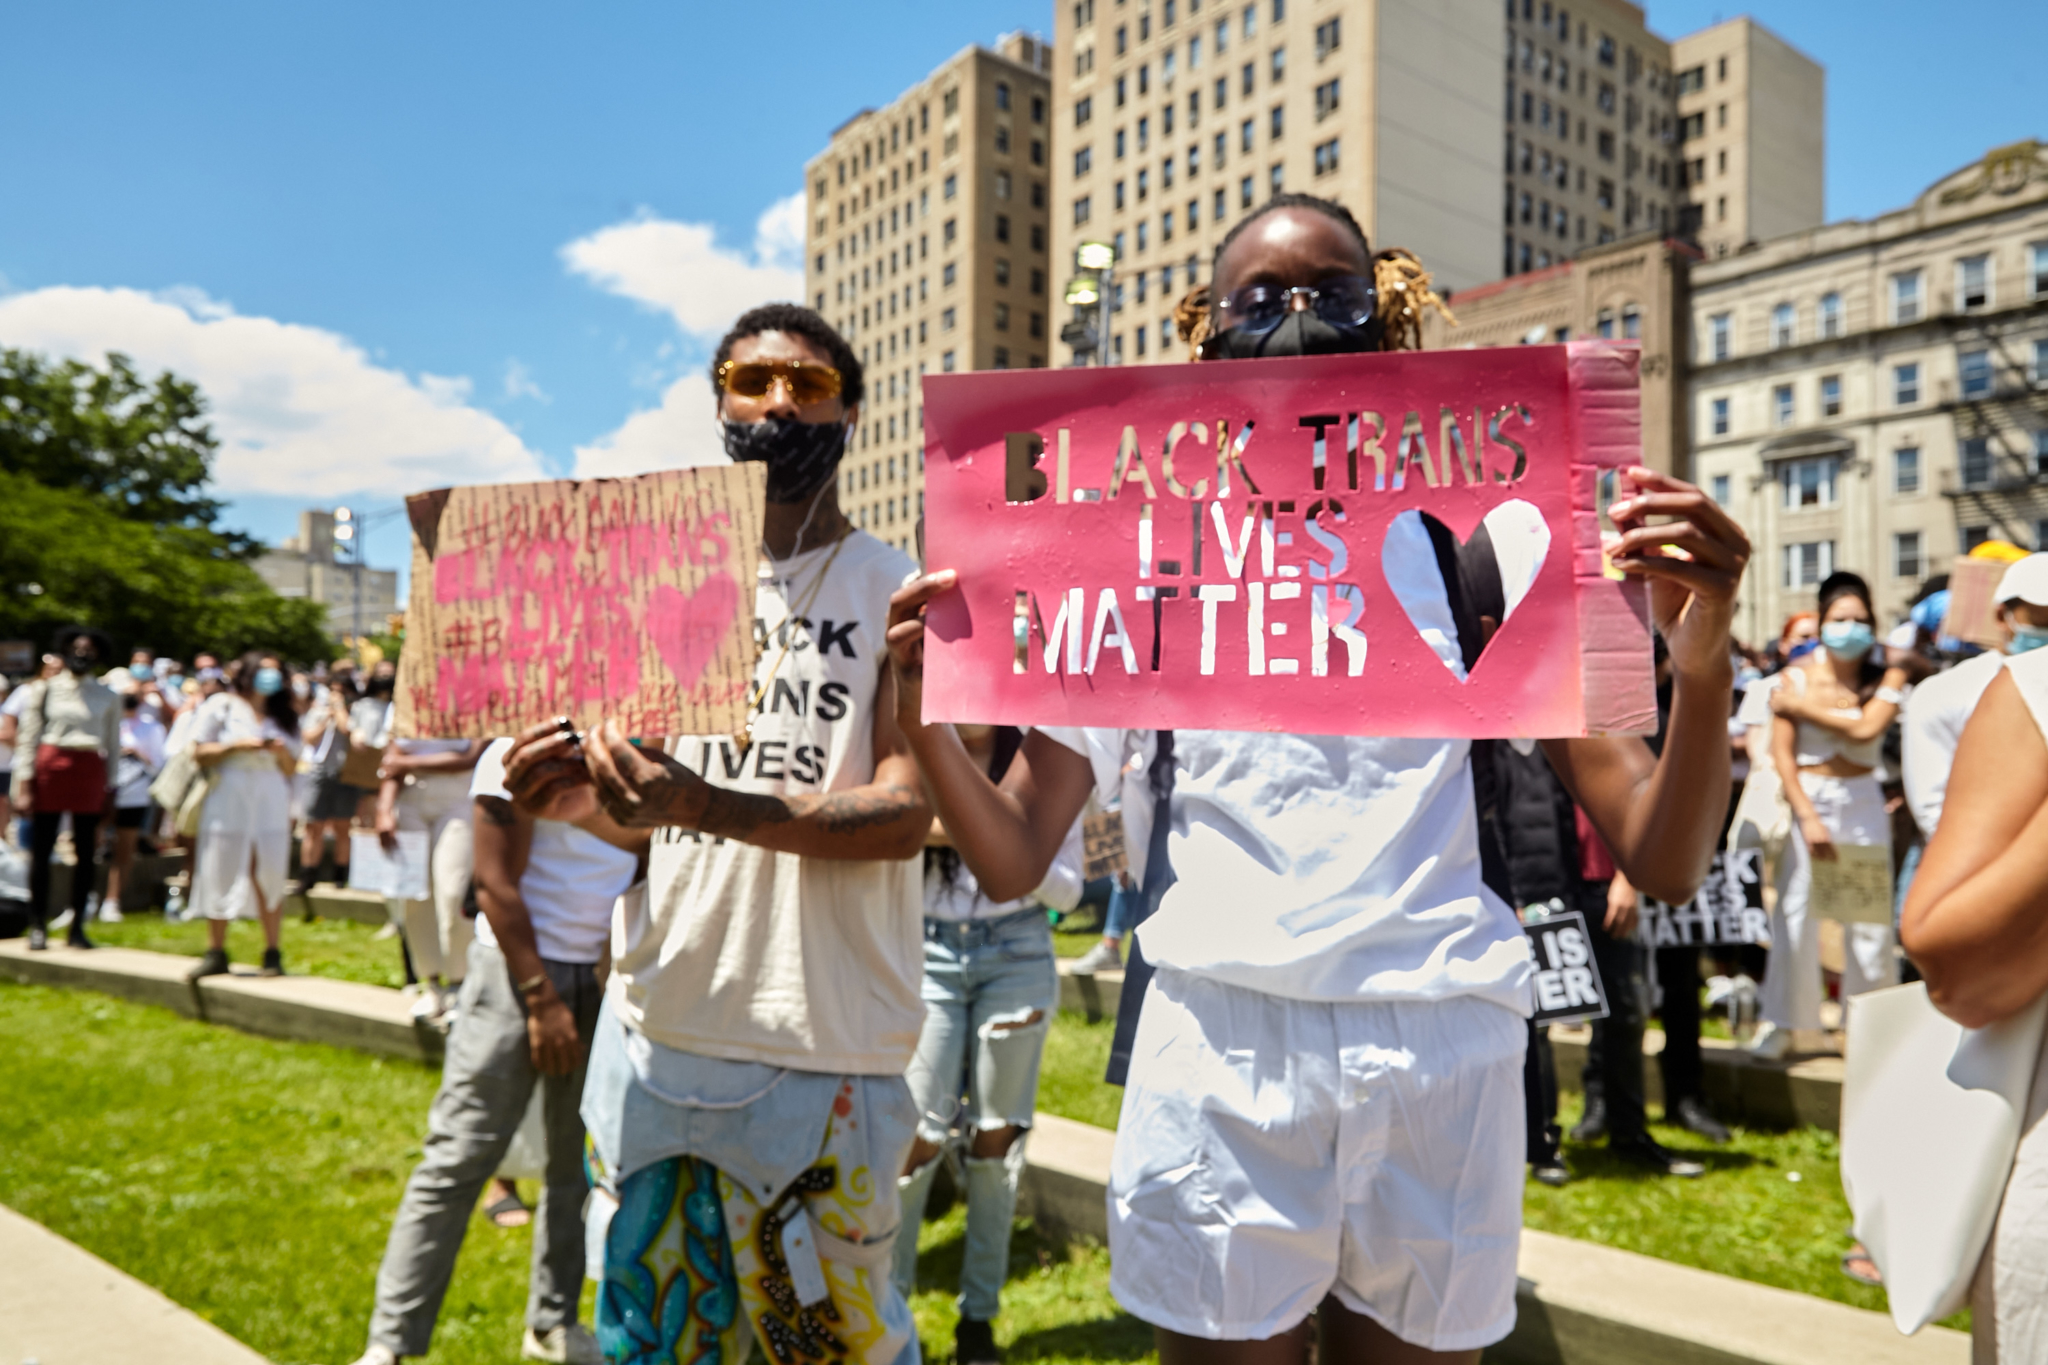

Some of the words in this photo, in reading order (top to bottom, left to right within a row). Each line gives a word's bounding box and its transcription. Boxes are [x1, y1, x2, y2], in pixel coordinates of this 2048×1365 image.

[1005, 420, 1262, 504] BLACK
[1298, 403, 1533, 494] TRANS
[600, 511, 730, 580] TRANS
[1138, 500, 1349, 580] LIVES
[755, 616, 860, 659] ACK
[1013, 581, 1368, 677] MATTER
[701, 741, 826, 786] IVES
[1542, 927, 1588, 970] IS
[1536, 967, 1601, 1011] ER
